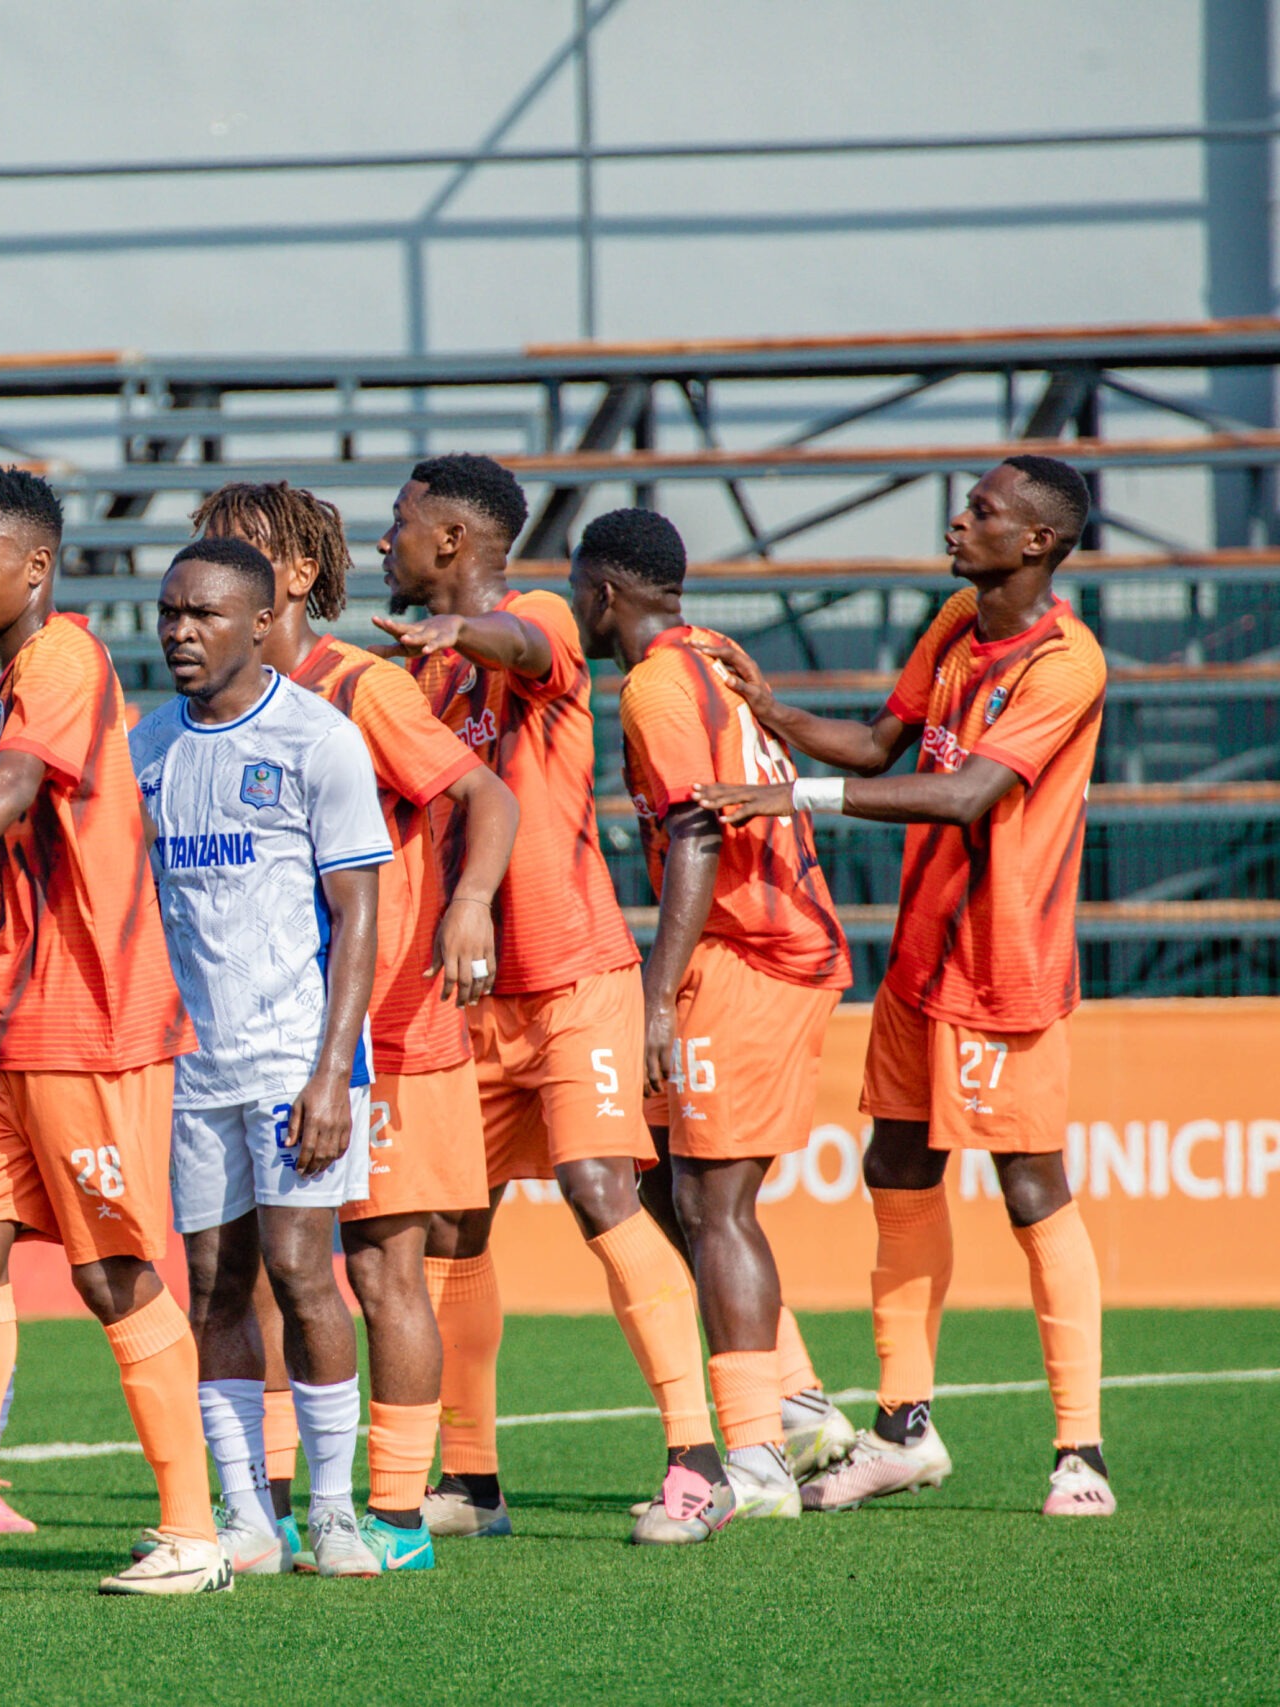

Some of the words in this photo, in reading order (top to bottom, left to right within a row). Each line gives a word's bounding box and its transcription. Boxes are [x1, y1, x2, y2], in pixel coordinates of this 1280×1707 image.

[169, 832, 256, 869] TANZANIA
[591, 1048, 619, 1094] 5
[668, 1037, 716, 1094] 46
[960, 1041, 1008, 1089] 27
[71, 1145, 125, 1198] 28
